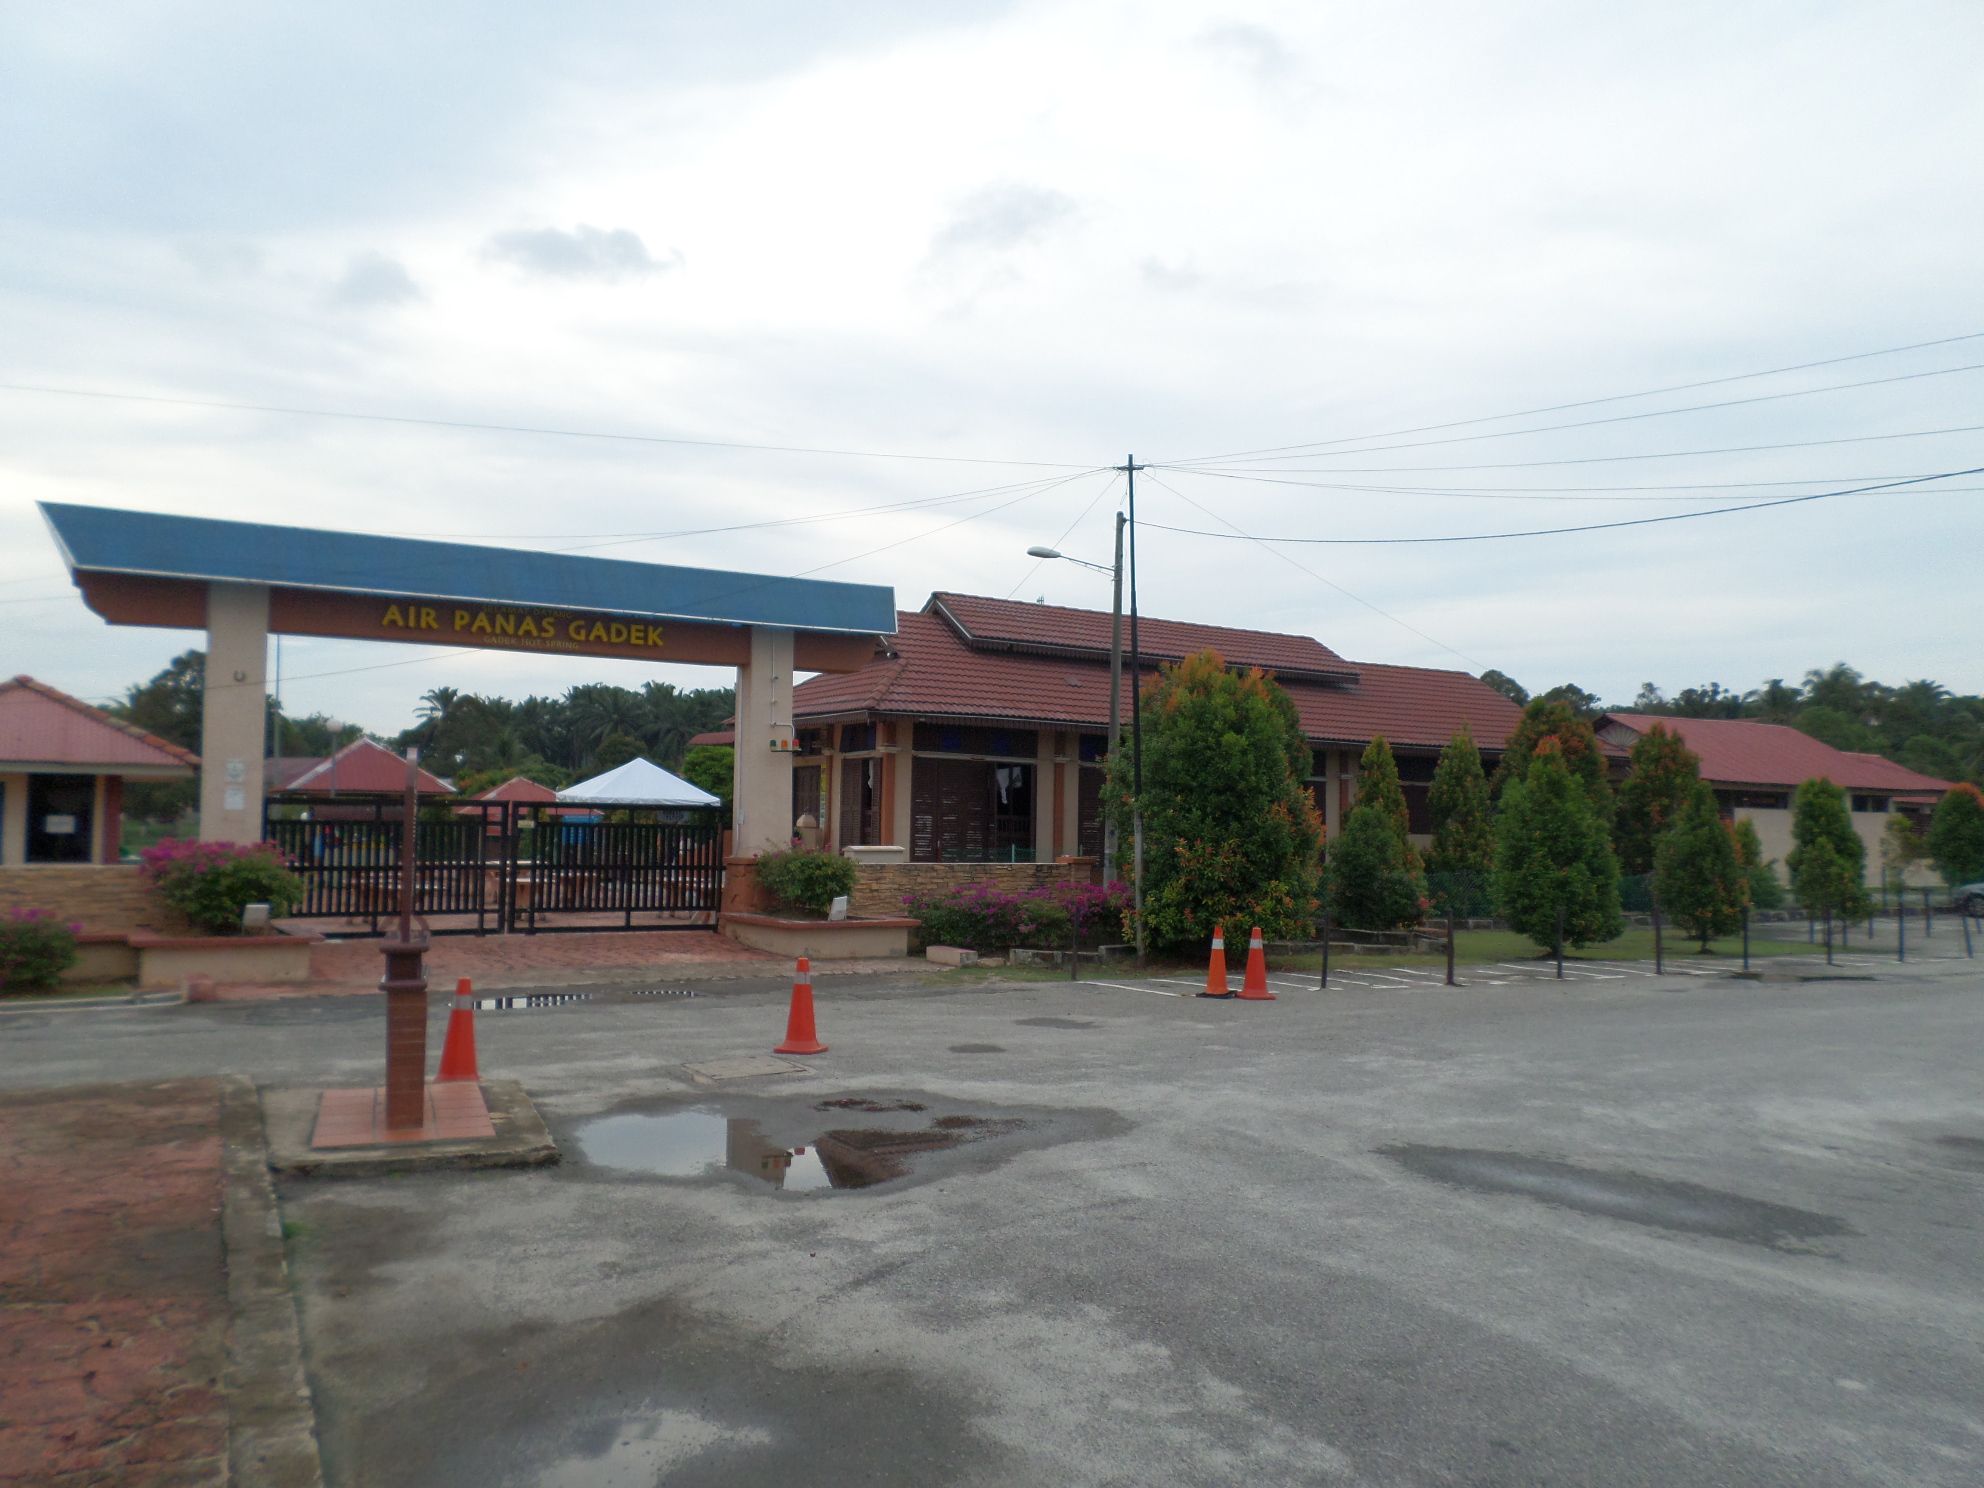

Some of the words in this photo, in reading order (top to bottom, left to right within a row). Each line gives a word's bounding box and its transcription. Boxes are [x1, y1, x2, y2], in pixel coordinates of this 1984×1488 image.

[381, 604, 439, 629] AIR
[454, 609, 555, 638] PANAS
[568, 620, 664, 646] GADEK
[483, 636, 517, 645] GADEK
[521, 638, 541, 646] HOT
[545, 640, 579, 649] SPRING
